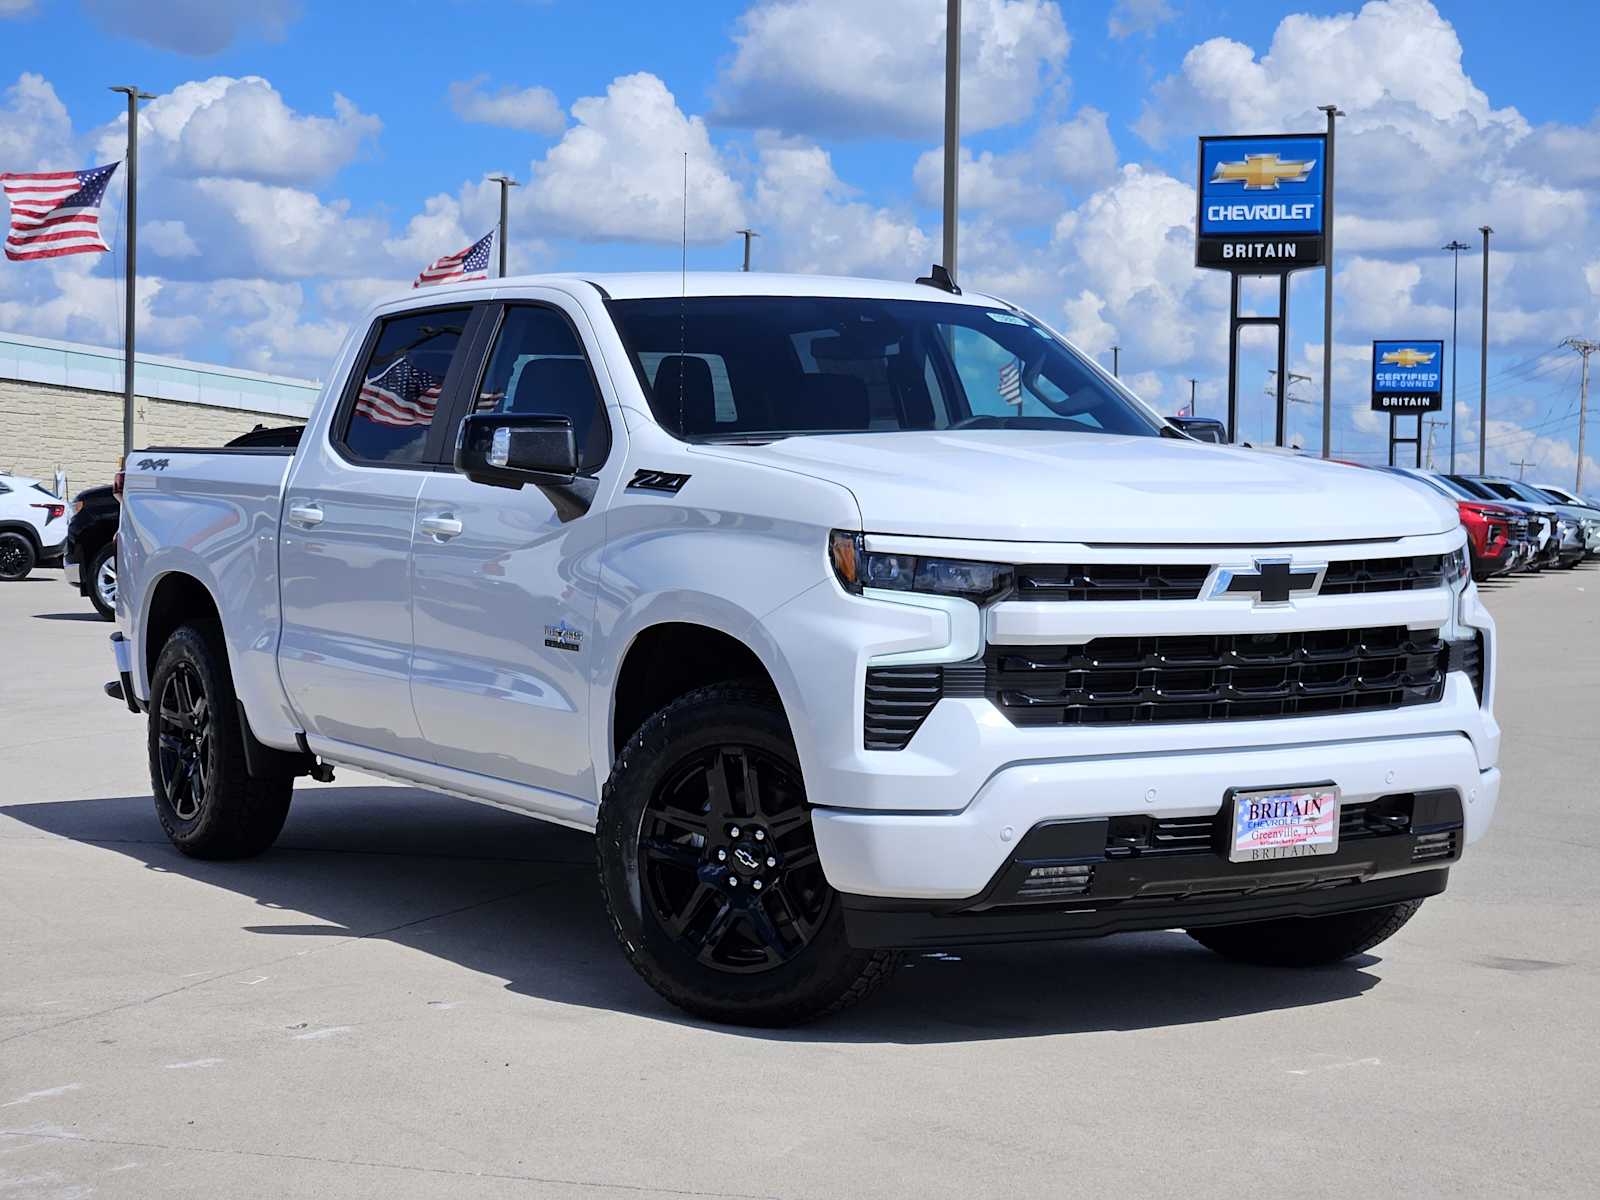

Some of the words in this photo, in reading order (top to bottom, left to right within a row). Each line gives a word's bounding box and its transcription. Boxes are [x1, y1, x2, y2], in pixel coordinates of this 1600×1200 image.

[1207, 203, 1315, 221] CHEVROLET
[1222, 243, 1297, 258] BRITAIN
[1376, 373, 1438, 381] CERTIFIED
[1382, 397, 1430, 406] BRITAIN
[1249, 798, 1323, 821] BRITAIN
[1247, 817, 1301, 829] CHEVROLET
[1251, 826, 1302, 841] Greenville,
[1304, 825, 1318, 836] TX
[1252, 843, 1318, 860] BRITAIN
